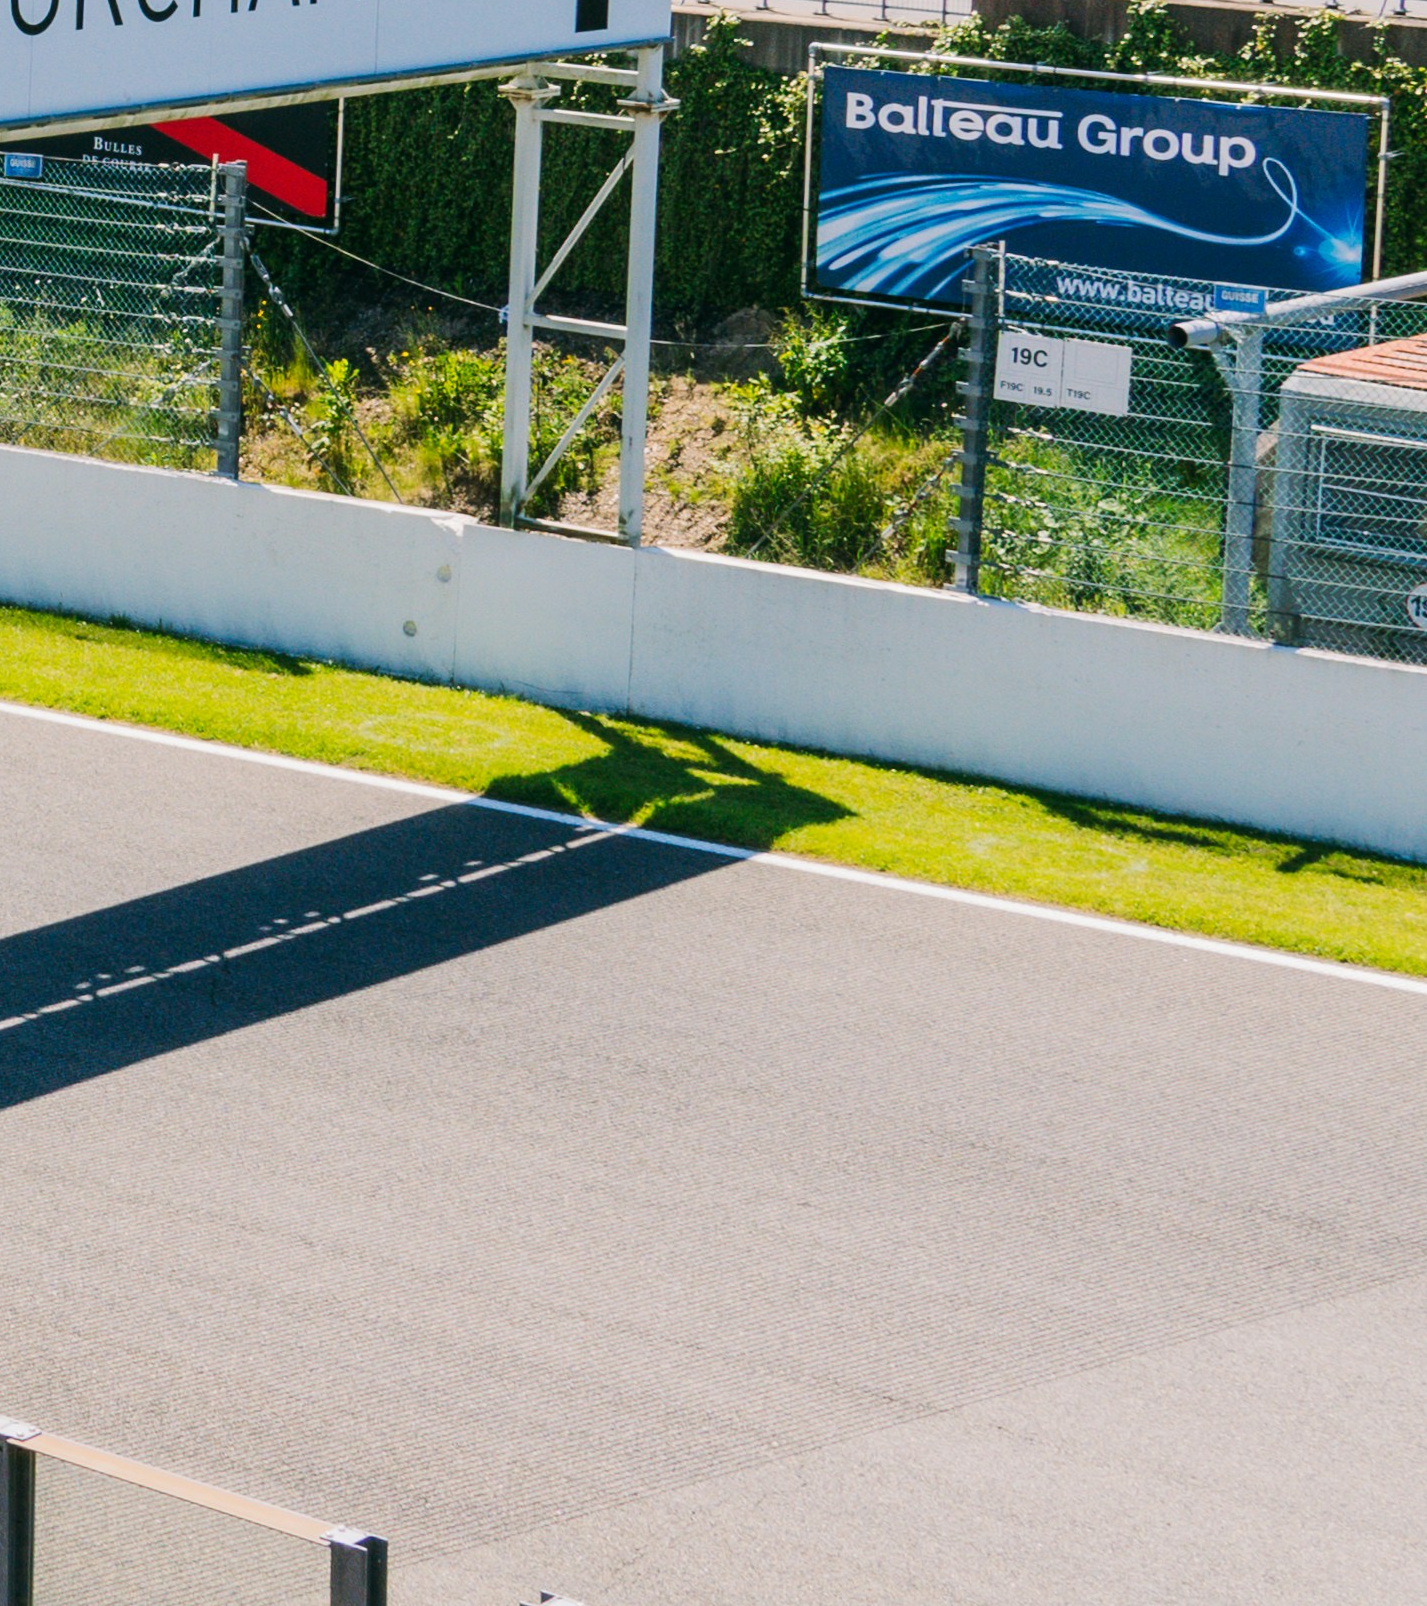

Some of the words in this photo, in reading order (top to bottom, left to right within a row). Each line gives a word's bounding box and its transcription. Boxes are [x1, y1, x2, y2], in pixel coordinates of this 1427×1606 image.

[846, 91, 1064, 150] Balteau
[1076, 113, 1256, 177] Group
[82, 153, 99, 166] DE
[1220, 289, 1260, 304] GUISSE
[1011, 346, 1049, 368] 19C
[999, 380, 1024, 392] F19C
[1033, 386, 1053, 397] 19.5
[1066, 388, 1091, 400] T19C
